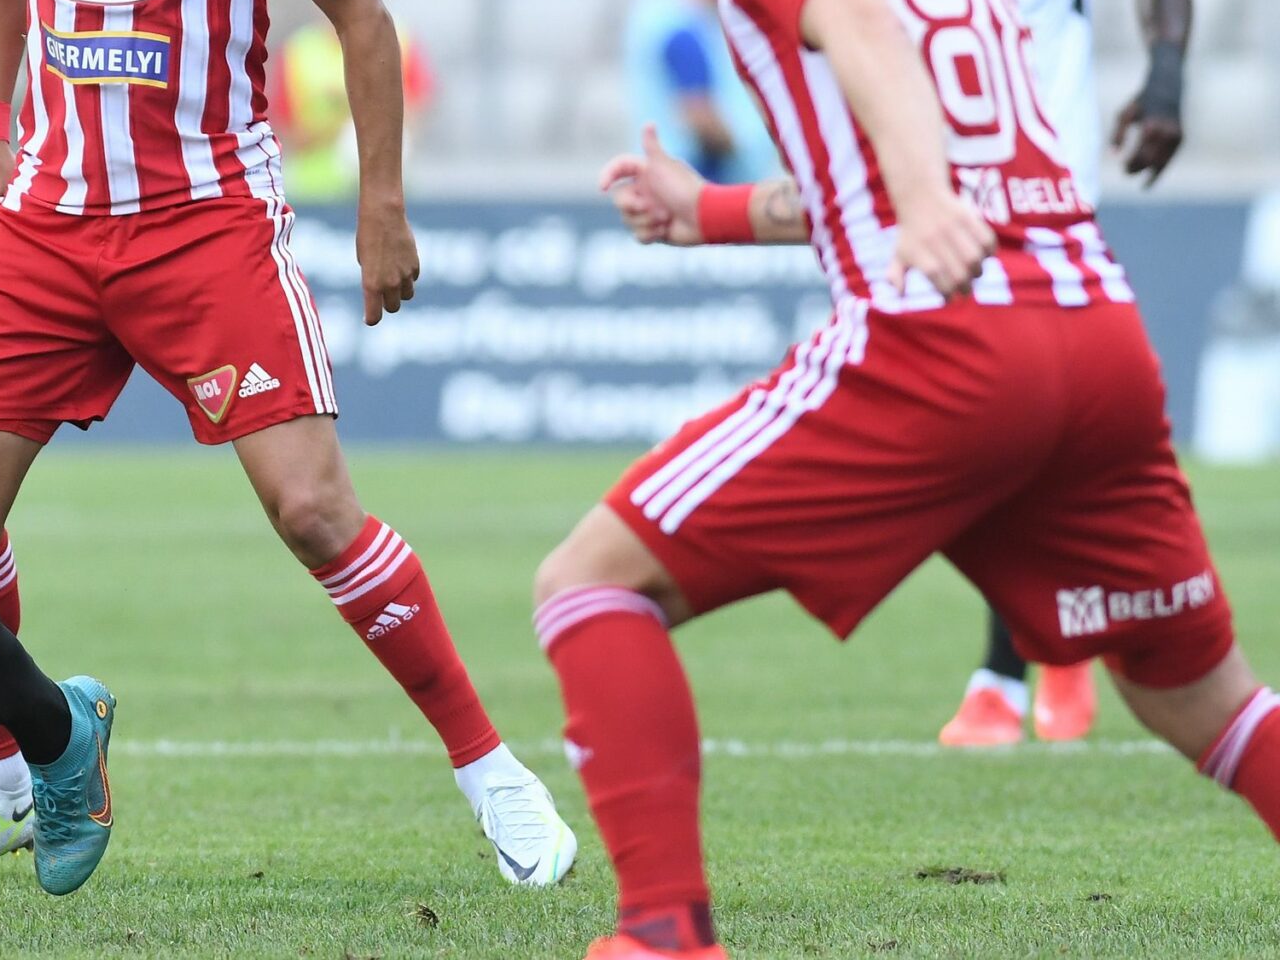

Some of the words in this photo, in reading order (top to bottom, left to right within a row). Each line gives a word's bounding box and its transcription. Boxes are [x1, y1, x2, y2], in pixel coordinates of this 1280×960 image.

[46, 36, 162, 74] GYERMELYI
[238, 377, 281, 398] adidas
[366, 603, 420, 641] adidas
